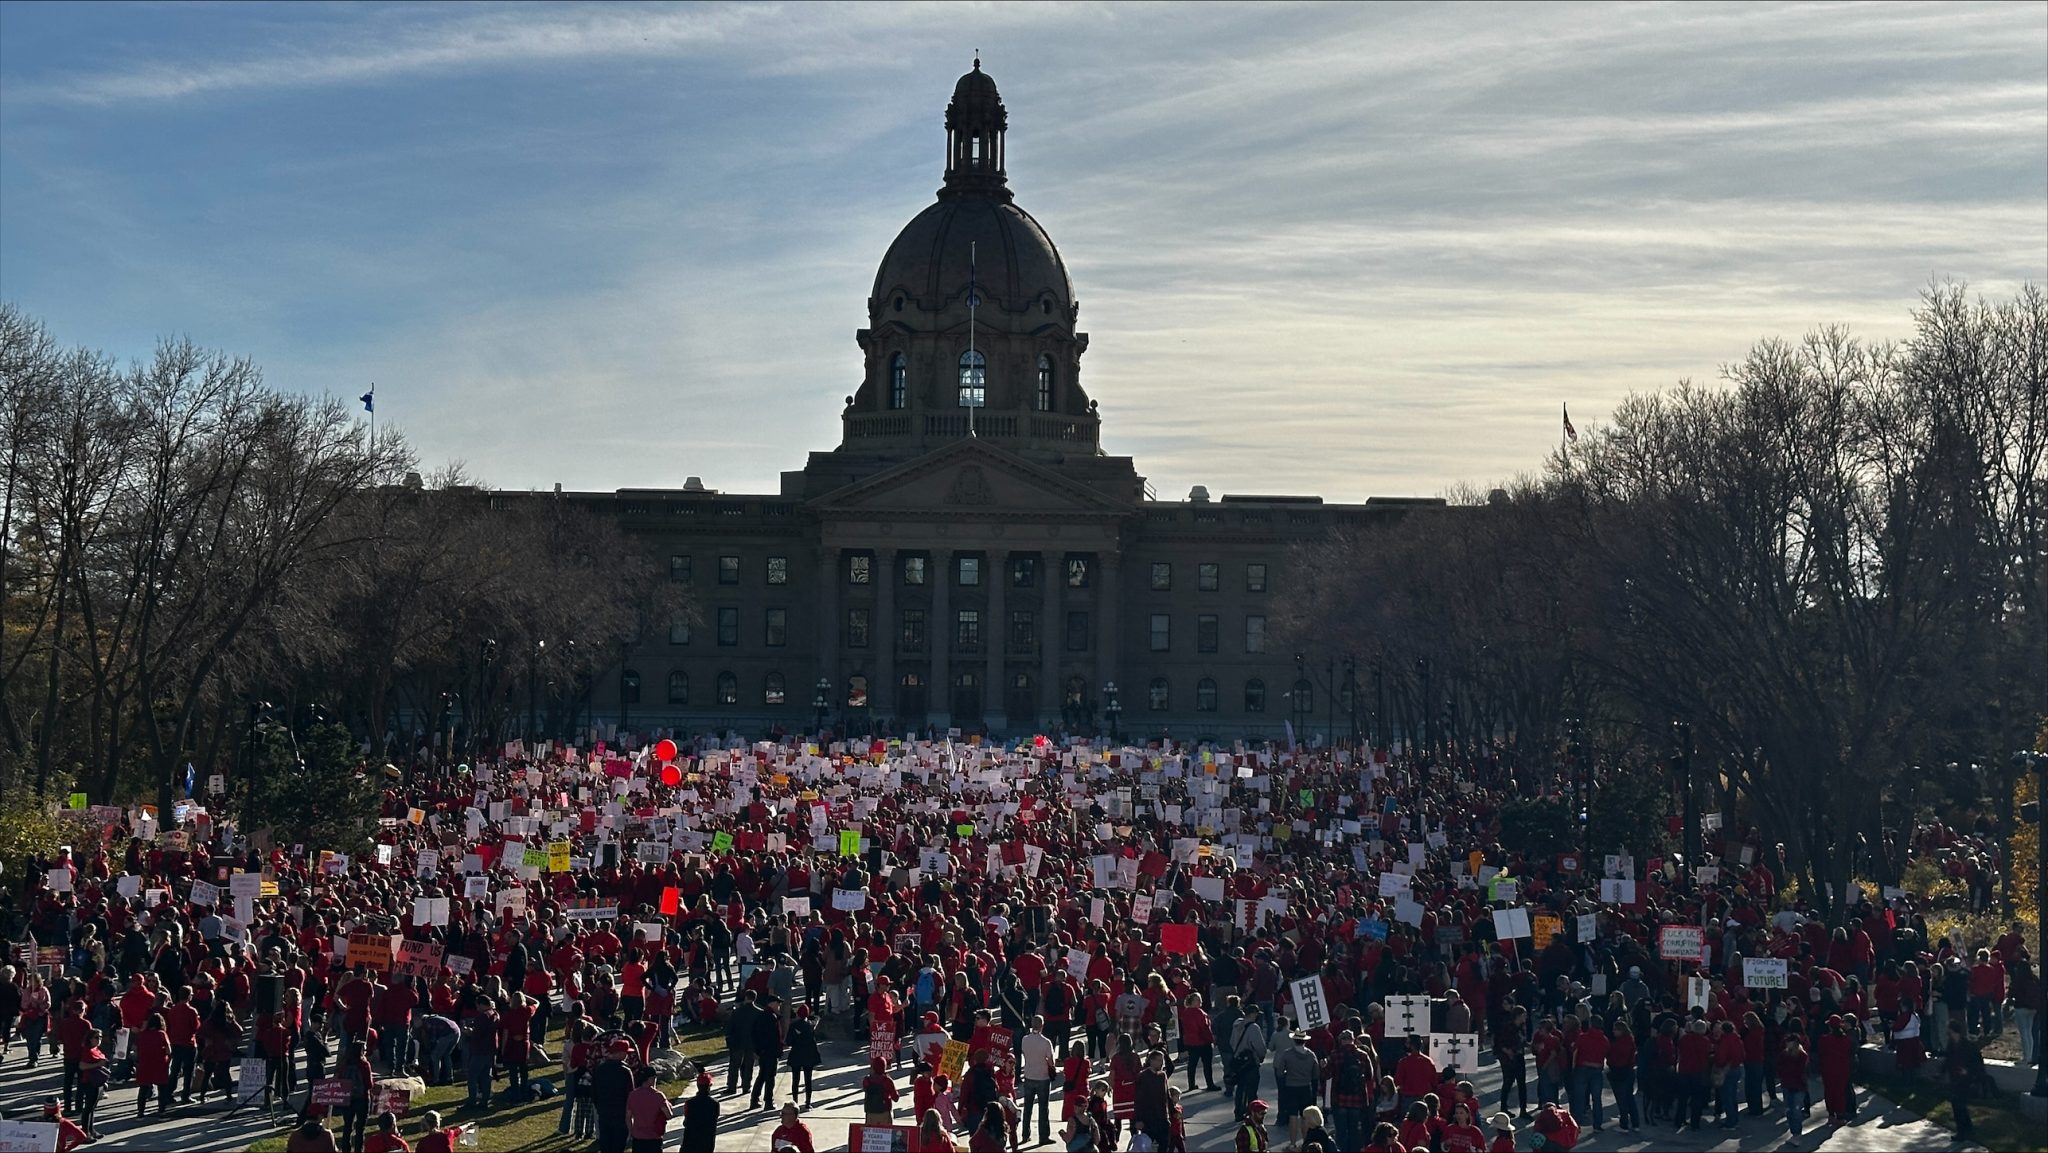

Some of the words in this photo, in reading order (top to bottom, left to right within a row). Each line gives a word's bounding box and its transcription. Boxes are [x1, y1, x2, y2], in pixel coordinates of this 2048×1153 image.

[400, 940, 424, 953] FUND
[430, 945, 442, 957] US
[394, 961, 415, 974] FUND
[1747, 974, 1786, 987] FUTURE!
[876, 1022, 887, 1031] WE
[871, 1031, 896, 1041] SUPPORT
[991, 1032, 1010, 1047] FIGHT
[870, 1041, 894, 1051] ALBERTA
